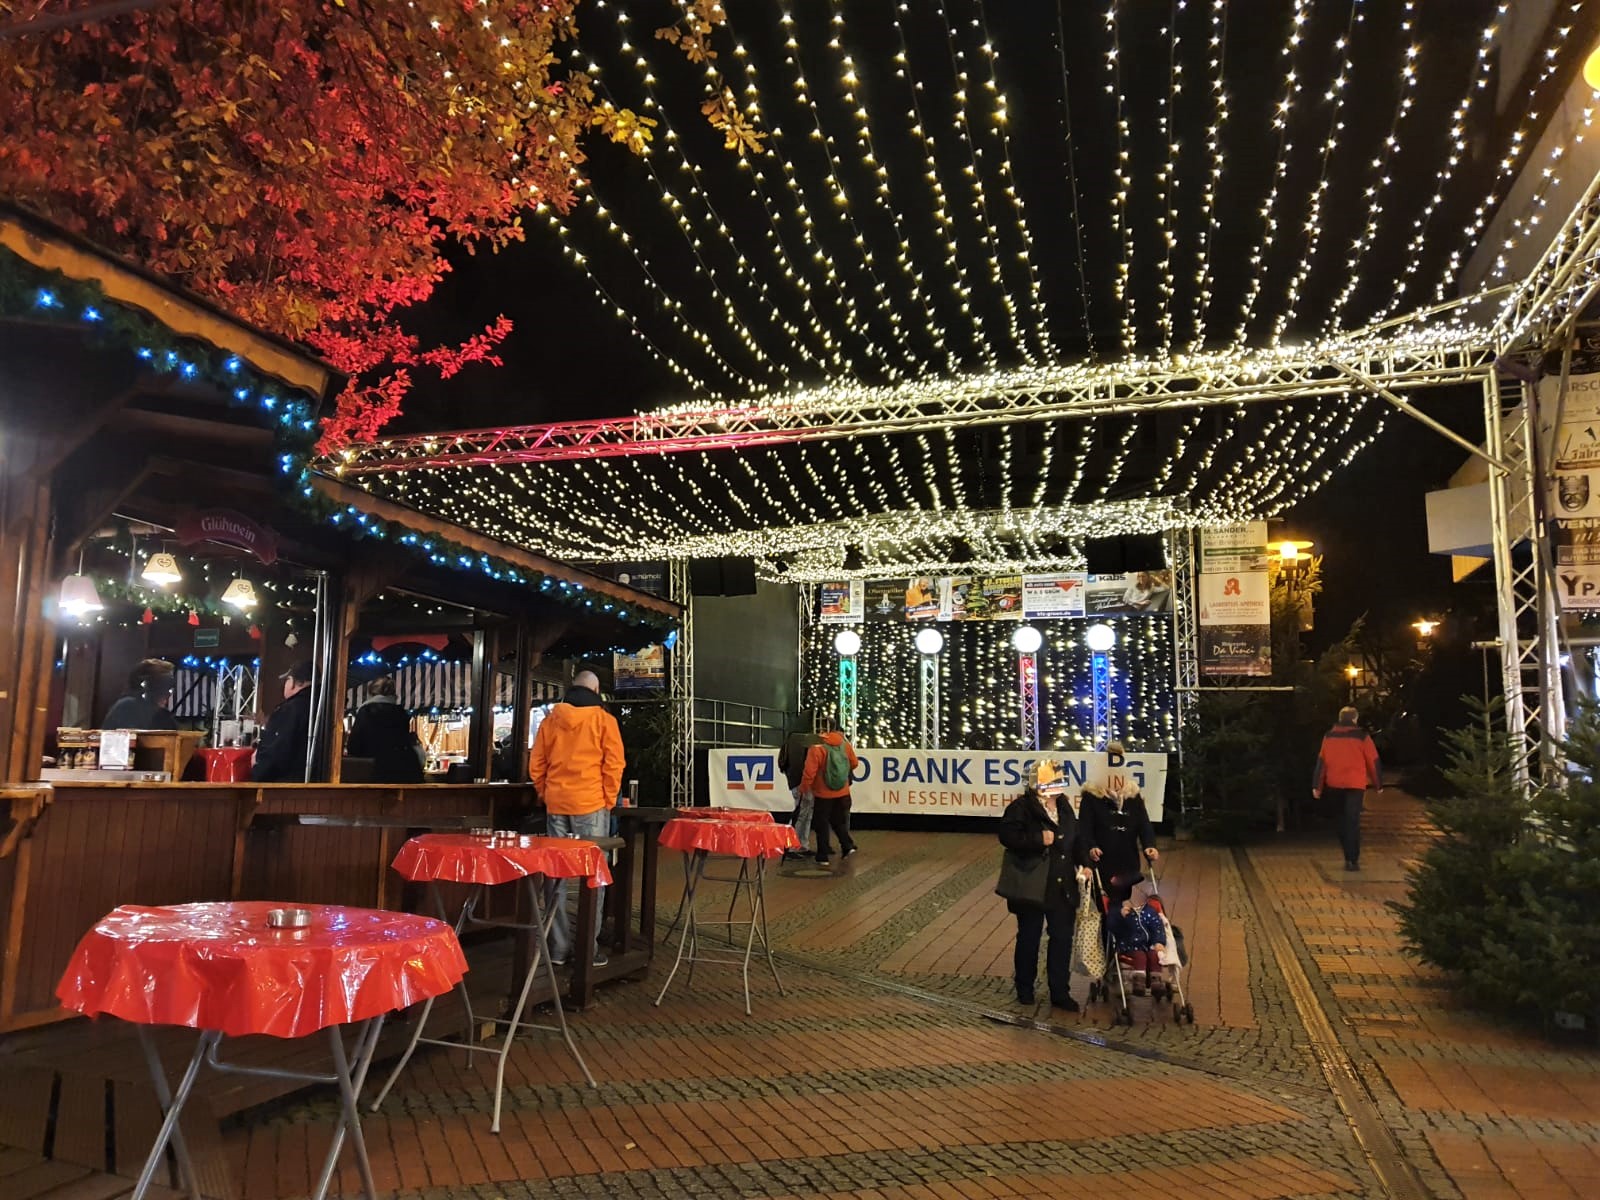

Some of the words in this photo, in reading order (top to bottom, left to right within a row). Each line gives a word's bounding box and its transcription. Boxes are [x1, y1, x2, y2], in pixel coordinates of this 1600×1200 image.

[201, 515, 255, 543] Glühwein
[882, 757, 972, 785] BANK
[984, 758, 1088, 787] ESN
[882, 790, 900, 804] IN
[908, 791, 962, 806] ESSEN
[971, 792, 1023, 808] MEH
